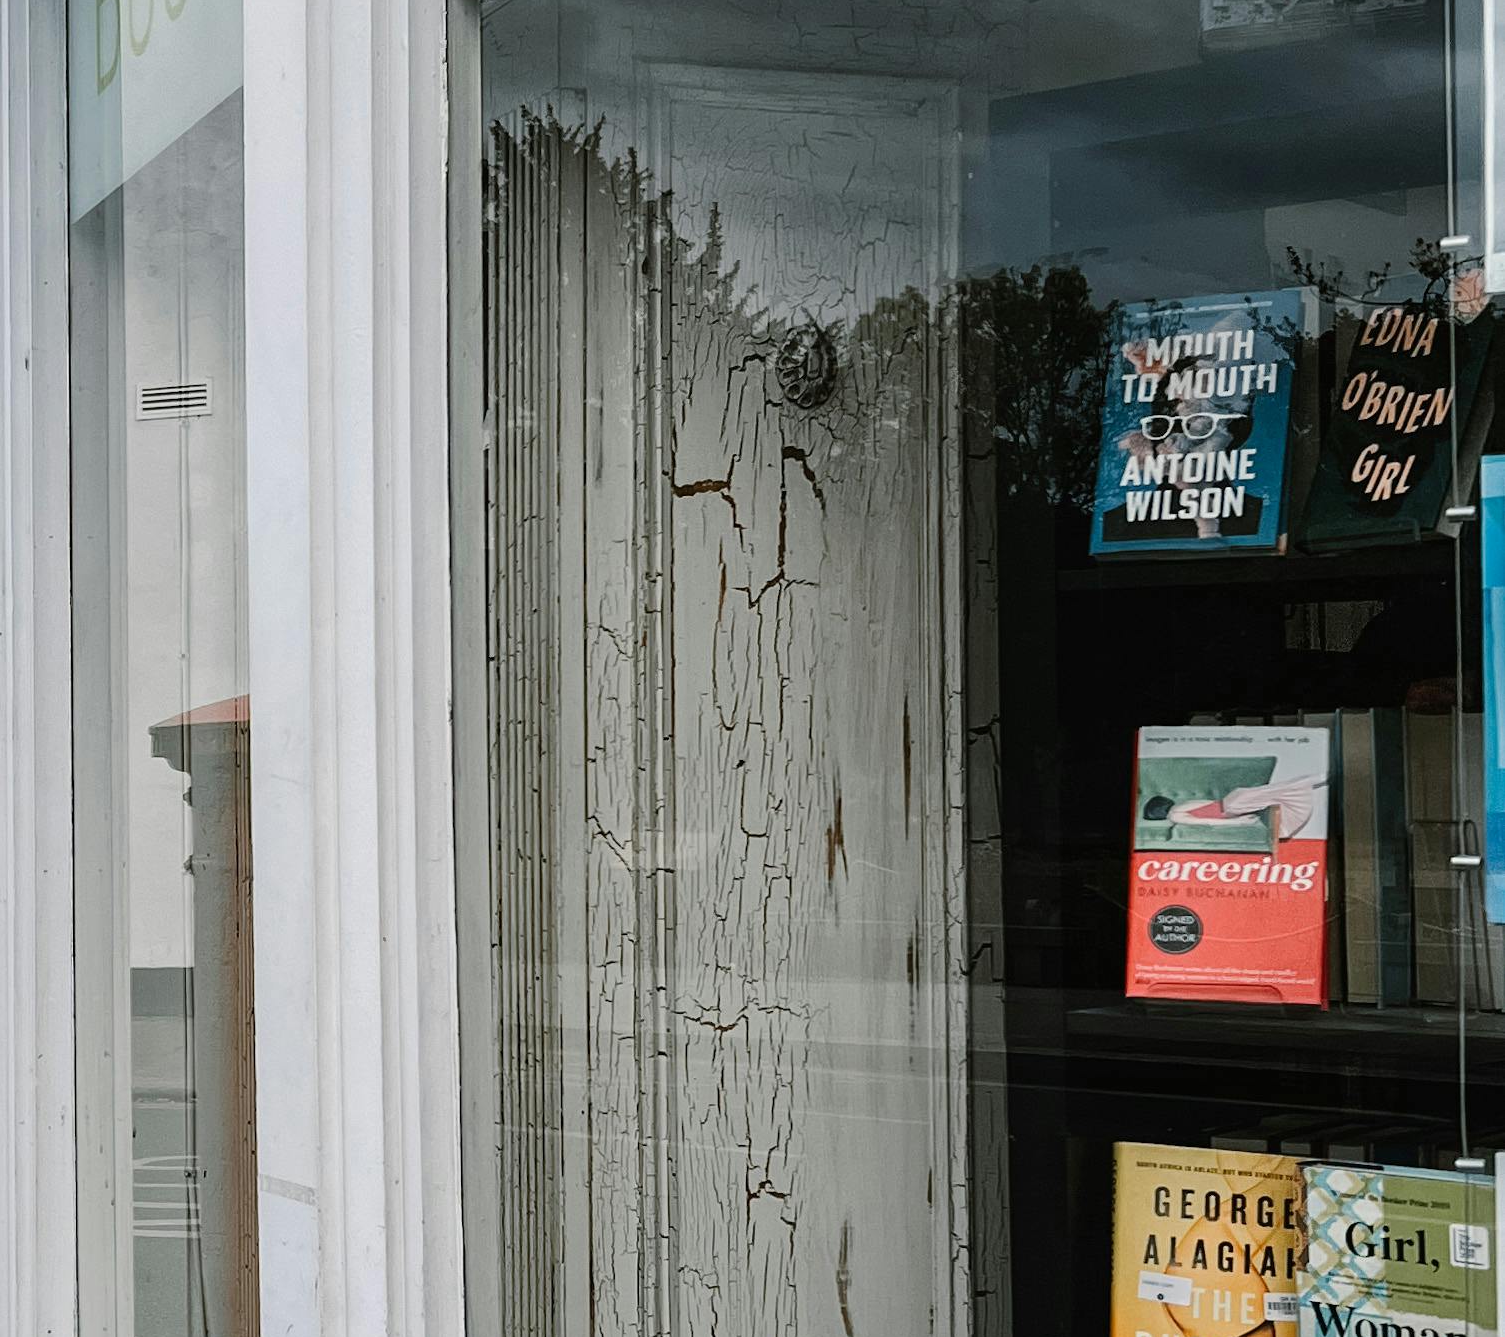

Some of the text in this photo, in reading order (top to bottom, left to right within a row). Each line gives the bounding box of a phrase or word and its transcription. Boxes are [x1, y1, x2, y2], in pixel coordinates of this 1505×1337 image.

[1145, 329, 1255, 368] MOUTH
[1360, 305, 1438, 358] EDNA
[1120, 363, 1278, 403] TO MOUTH
[1341, 370, 1455, 434] O'BRIEN
[1119, 448, 1258, 488] ANTOINE
[1350, 442, 1416, 502] GIRL
[1124, 485, 1246, 523] WILSON
[1137, 855, 1320, 892] careering
[1137, 887, 1179, 898] DAISY
[1153, 933, 1196, 943] AUTHOR
[1156, 914, 1195, 925] SIGNED
[1154, 1185, 1295, 1230] GEORGE
[1345, 1221, 1440, 1273] Girl,
[1192, 1286, 1256, 1325] THE
